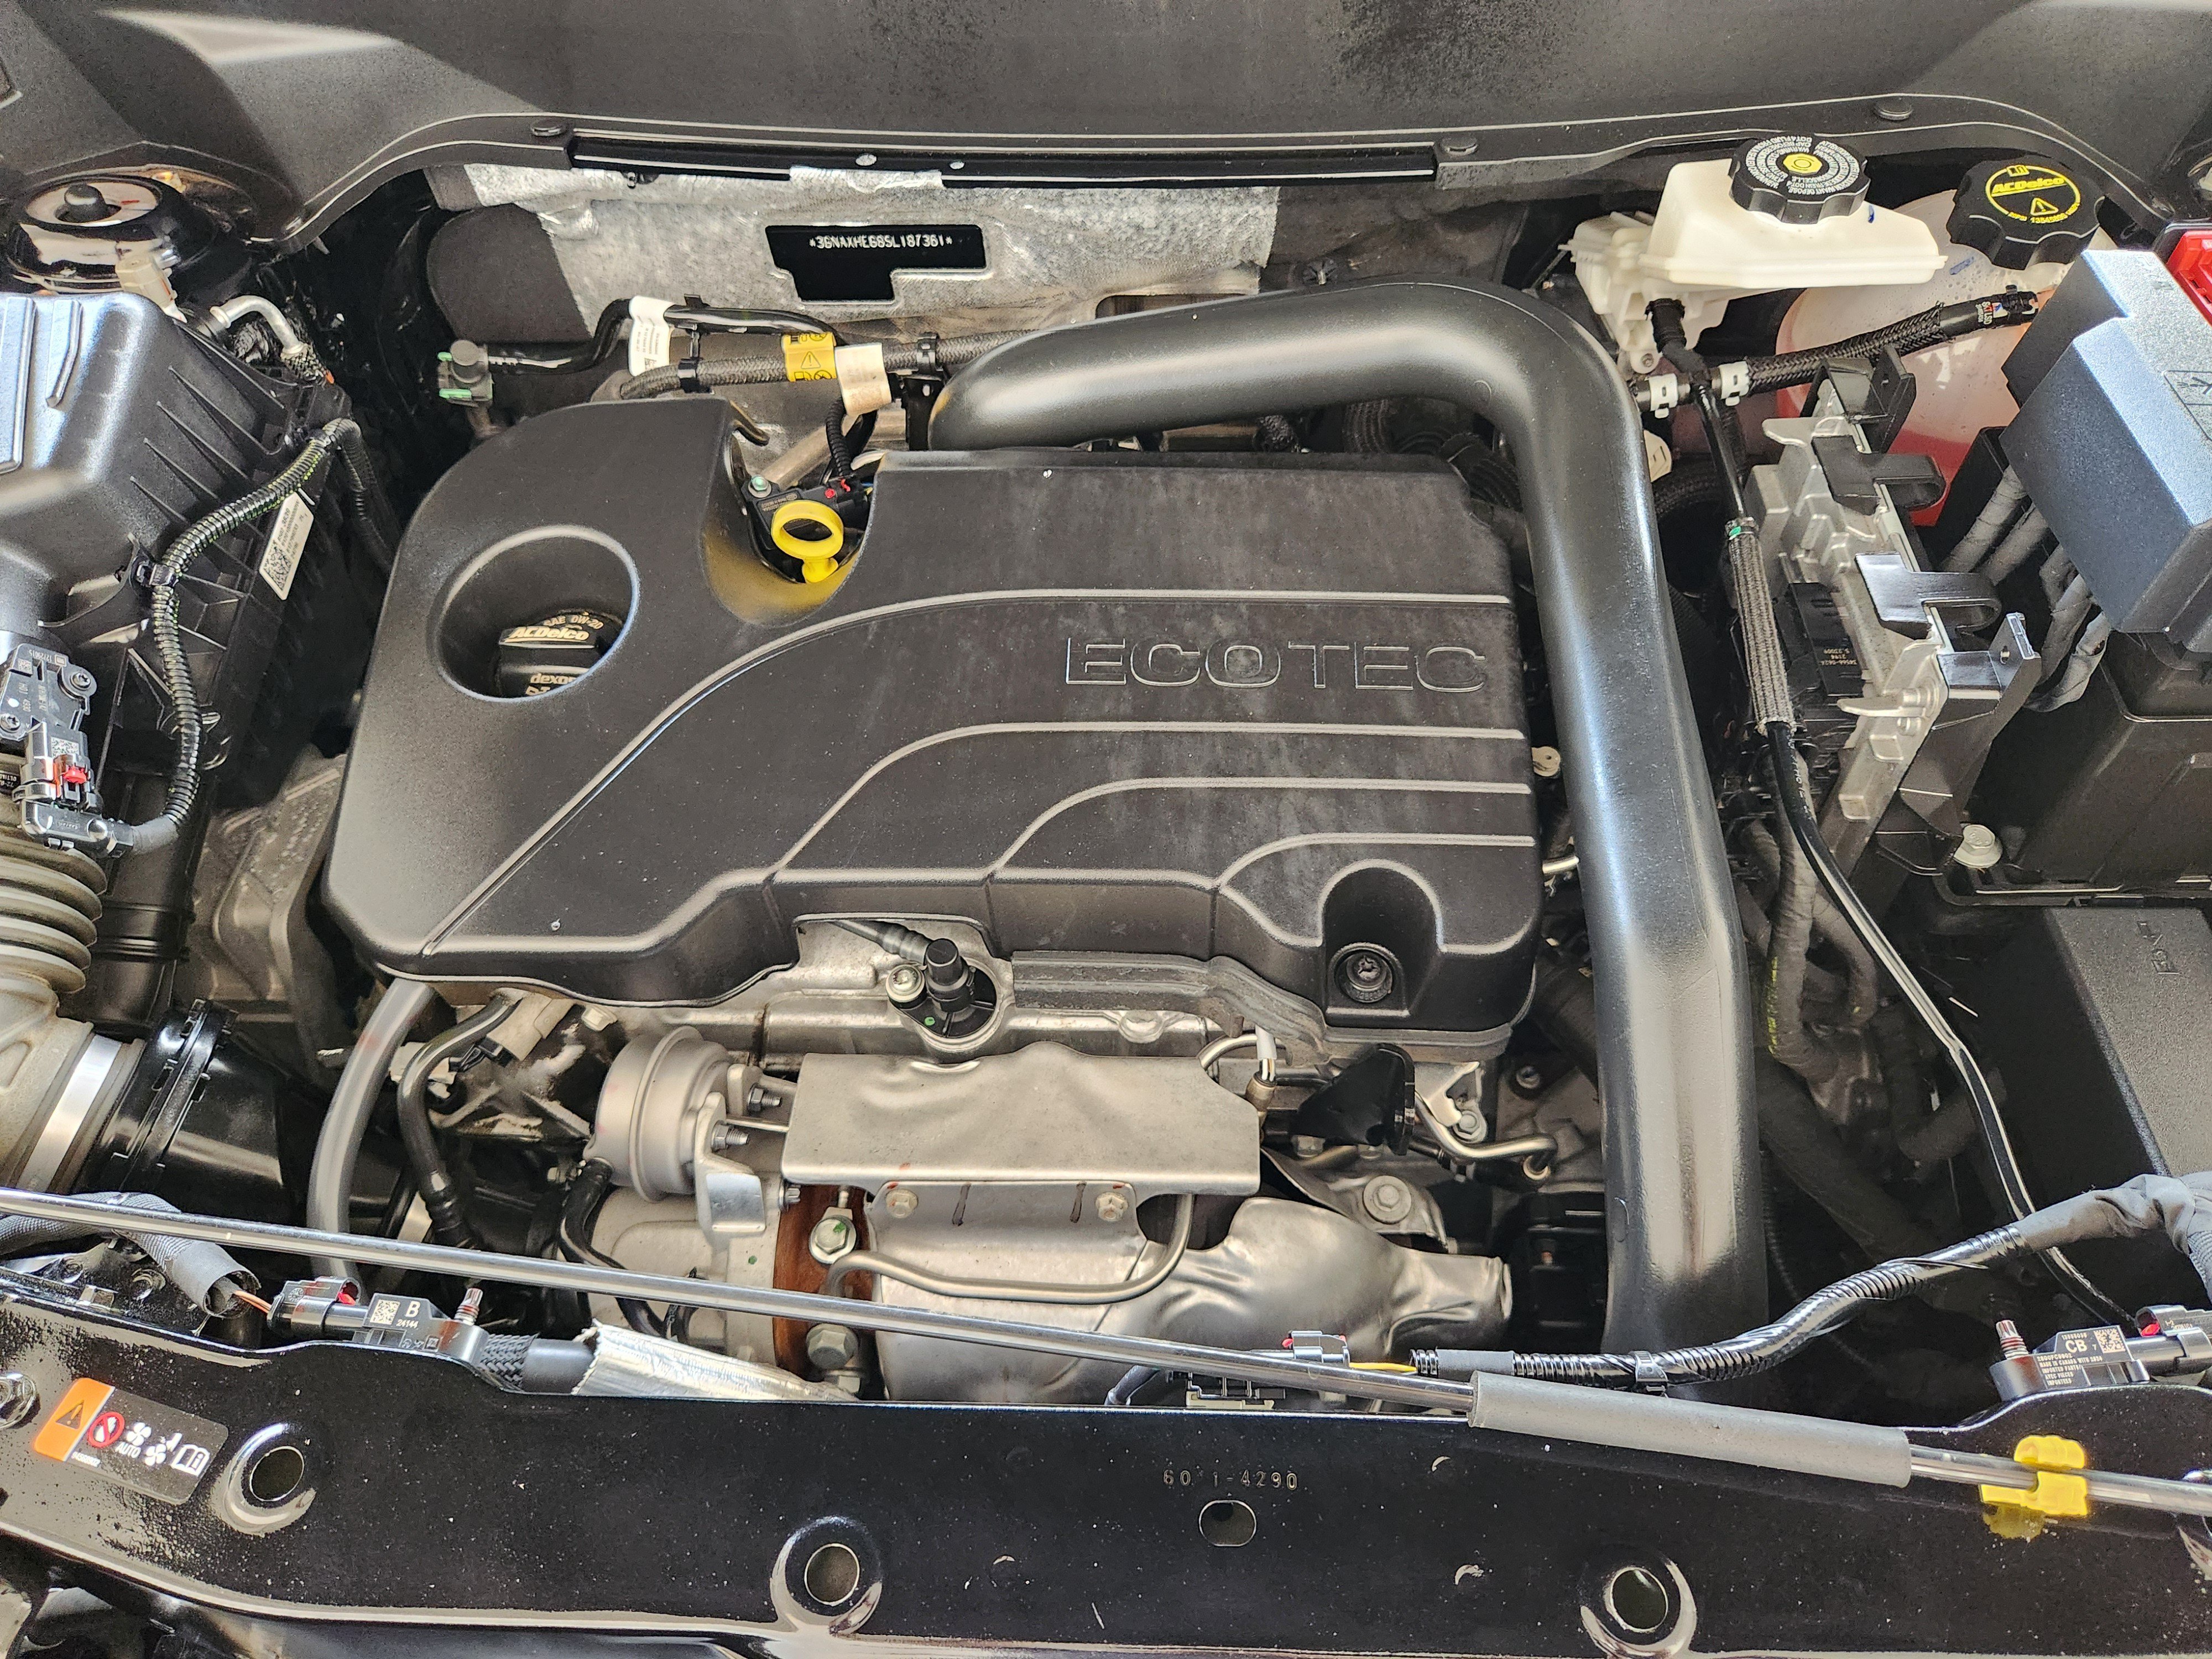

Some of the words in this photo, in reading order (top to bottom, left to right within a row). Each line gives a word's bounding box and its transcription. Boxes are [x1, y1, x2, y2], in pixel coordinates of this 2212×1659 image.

[1992, 178, 2065, 193] ACDelco
[543, 615, 566, 627] SAE
[570, 614, 604, 630] 0W-20
[508, 625, 589, 641] ACDelco
[1065, 637, 1486, 692] ECOTEC
[404, 1300, 421, 1318] B
[2065, 1339, 2088, 1353] CB
[114, 1442, 141, 1459] AUTO
